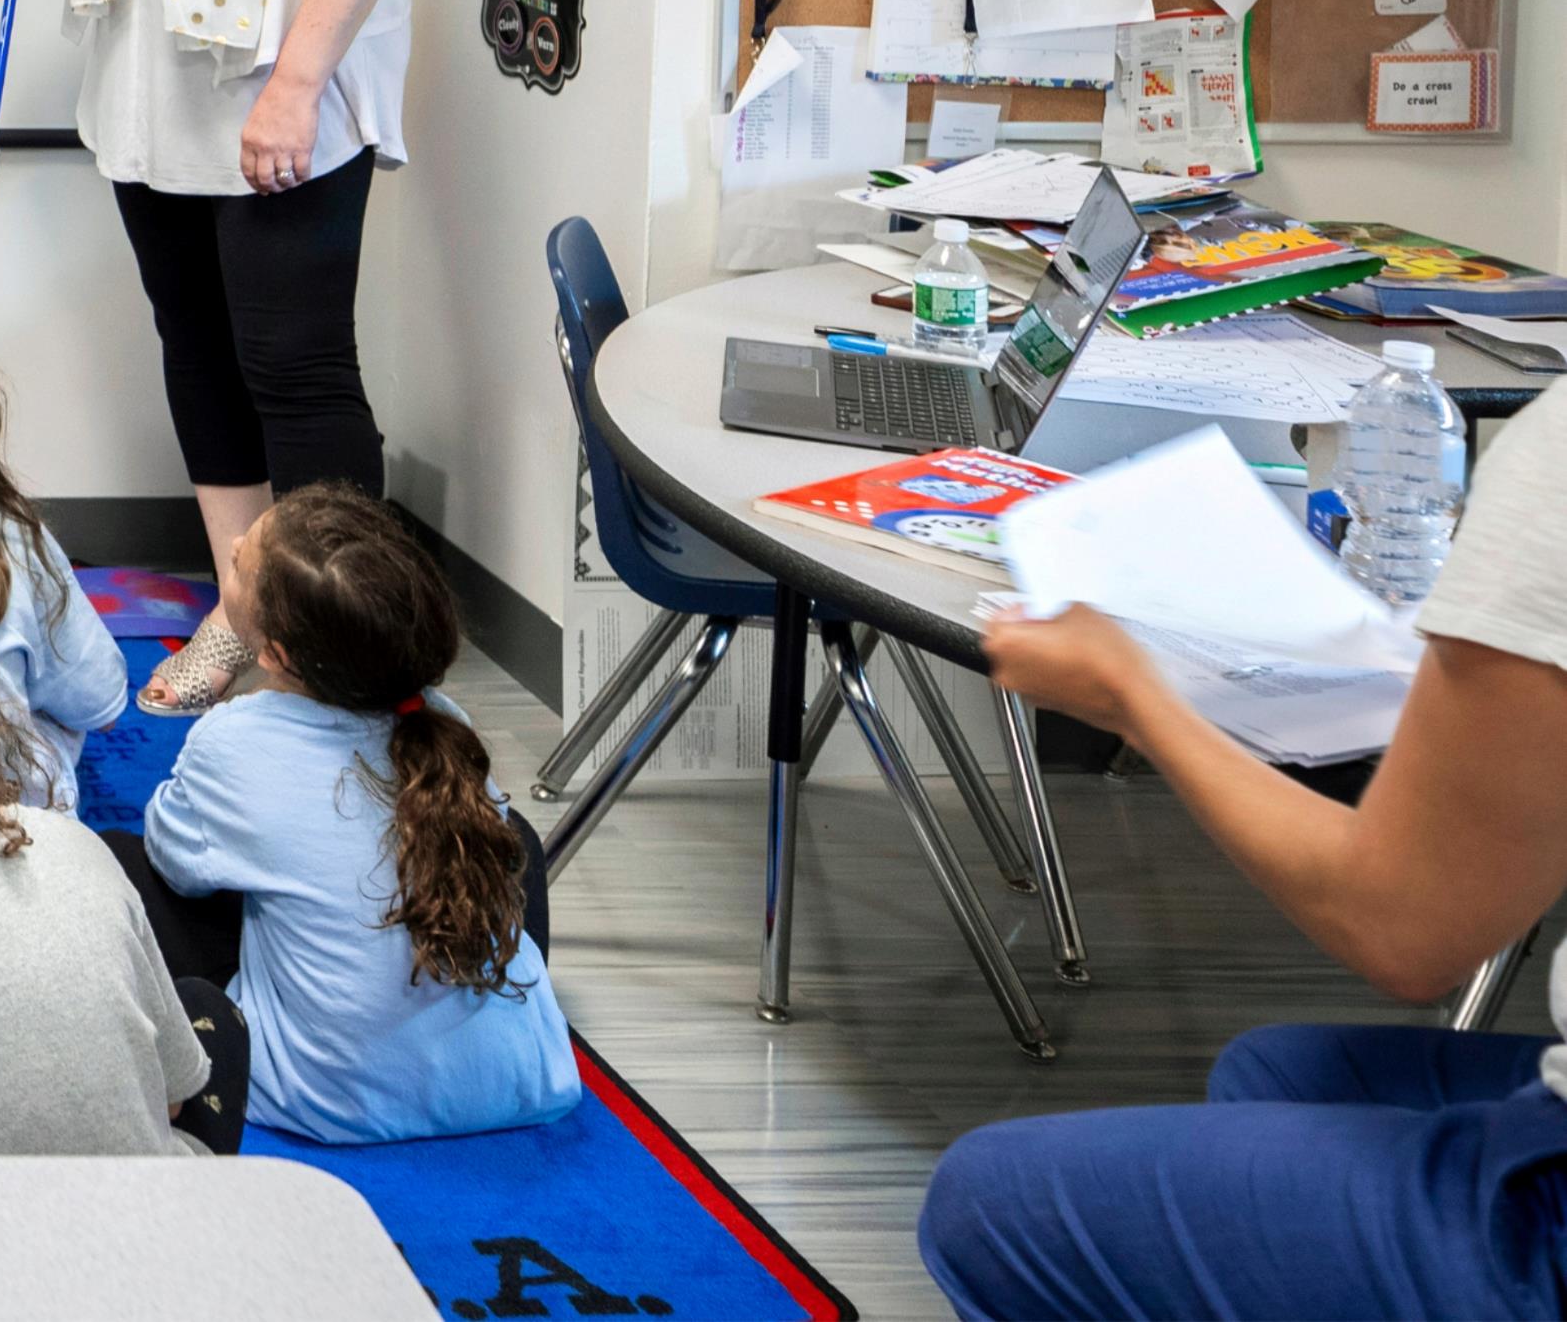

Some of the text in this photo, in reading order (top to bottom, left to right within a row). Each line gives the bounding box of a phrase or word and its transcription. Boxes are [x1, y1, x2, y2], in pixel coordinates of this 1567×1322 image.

[1393, 82, 1408, 91] Do
[1425, 83, 1452, 91] cross
[1407, 95, 1437, 105] crawl
